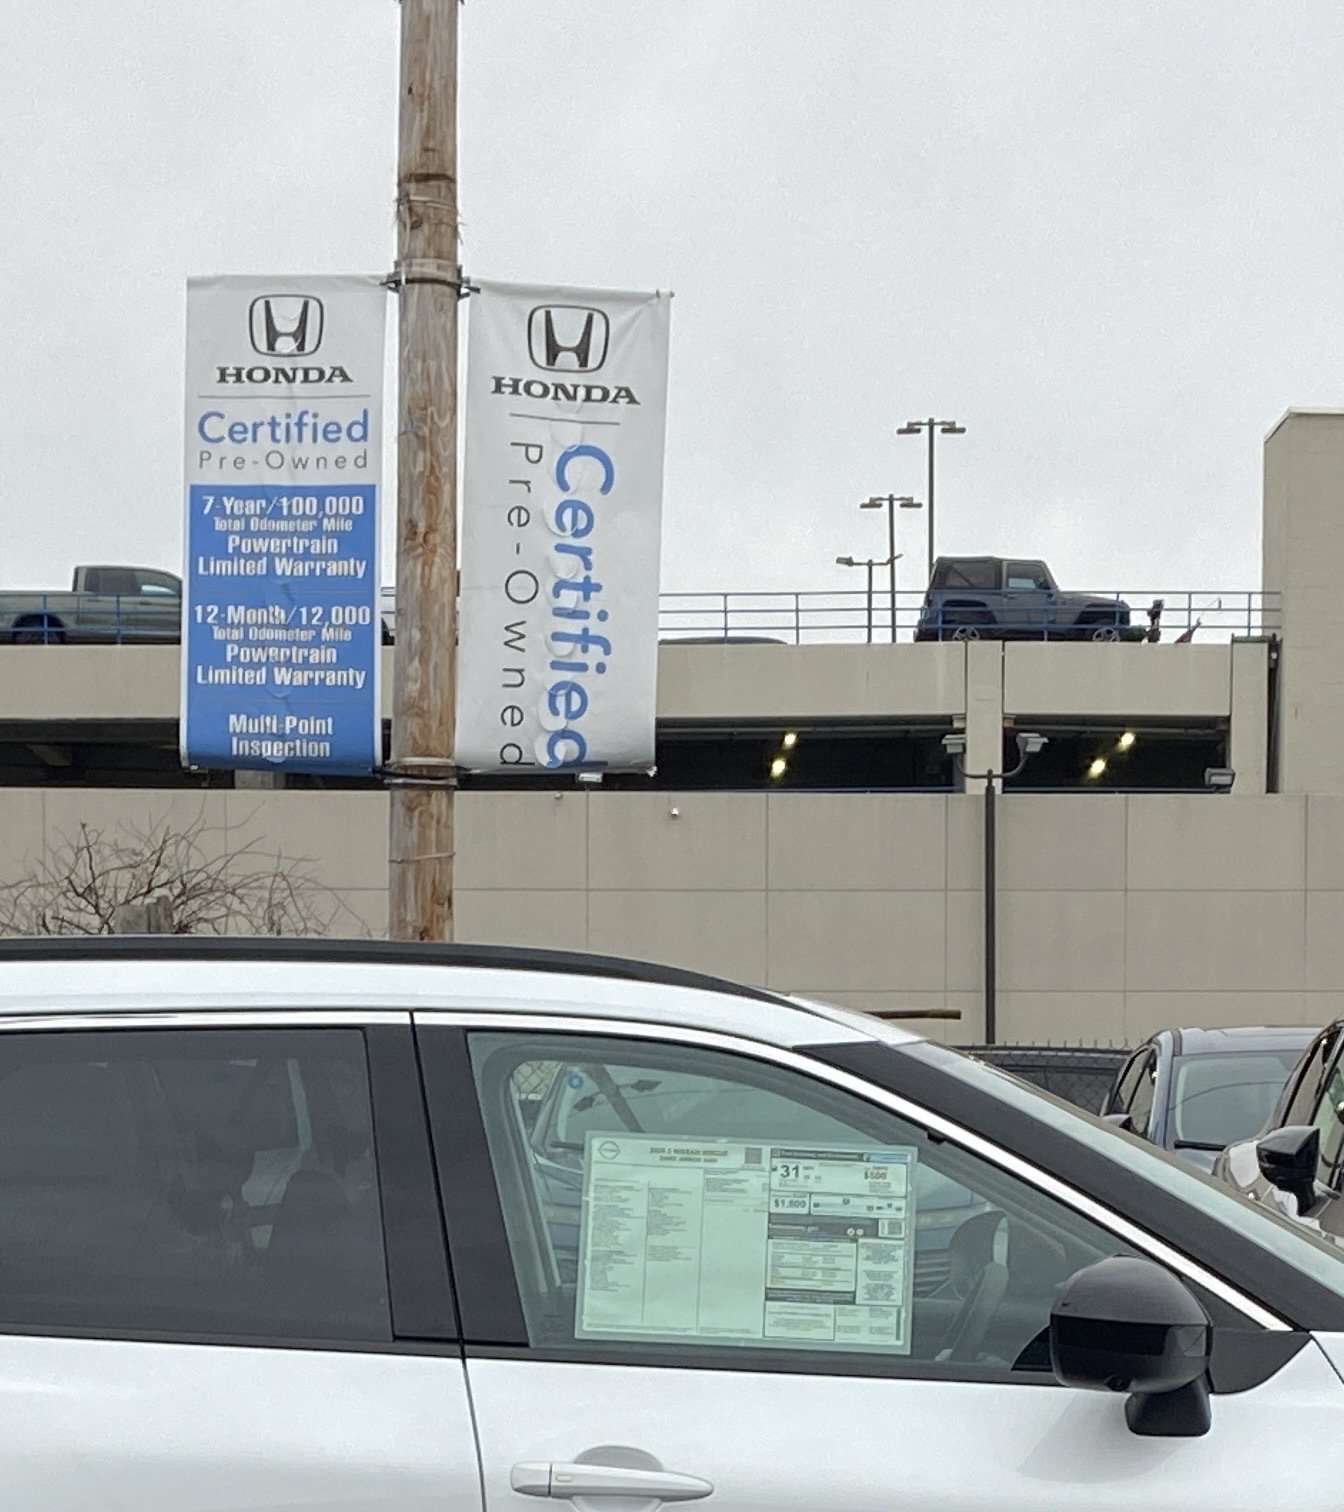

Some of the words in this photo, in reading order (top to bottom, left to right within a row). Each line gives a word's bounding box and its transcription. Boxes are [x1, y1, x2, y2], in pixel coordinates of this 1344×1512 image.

[216, 366, 354, 384] HONDA
[491, 376, 641, 405] HONDA
[197, 408, 369, 444] Certified
[199, 449, 368, 469] Pre-Owned
[202, 495, 364, 518] 7-Year/100,000
[214, 516, 246, 531] Total
[250, 517, 317, 532] Odometer
[322, 518, 353, 532] Mile
[227, 534, 339, 555] Powertrain
[197, 556, 267, 576] Limited
[274, 557, 367, 579] Warranty
[499, 442, 544, 766] Pre-Owned
[546, 444, 615, 768] Certified
[194, 604, 371, 629] 12-Month/12,000
[212, 625, 244, 641] Total
[248, 626, 316, 641] Odometer
[321, 627, 353, 641] Mile
[225, 643, 338, 664] Powertrain
[196, 665, 267, 685] Limited
[273, 666, 366, 689] Warranty
[228, 713, 334, 735] Multi-Point
[231, 736, 331, 758] Inspection
